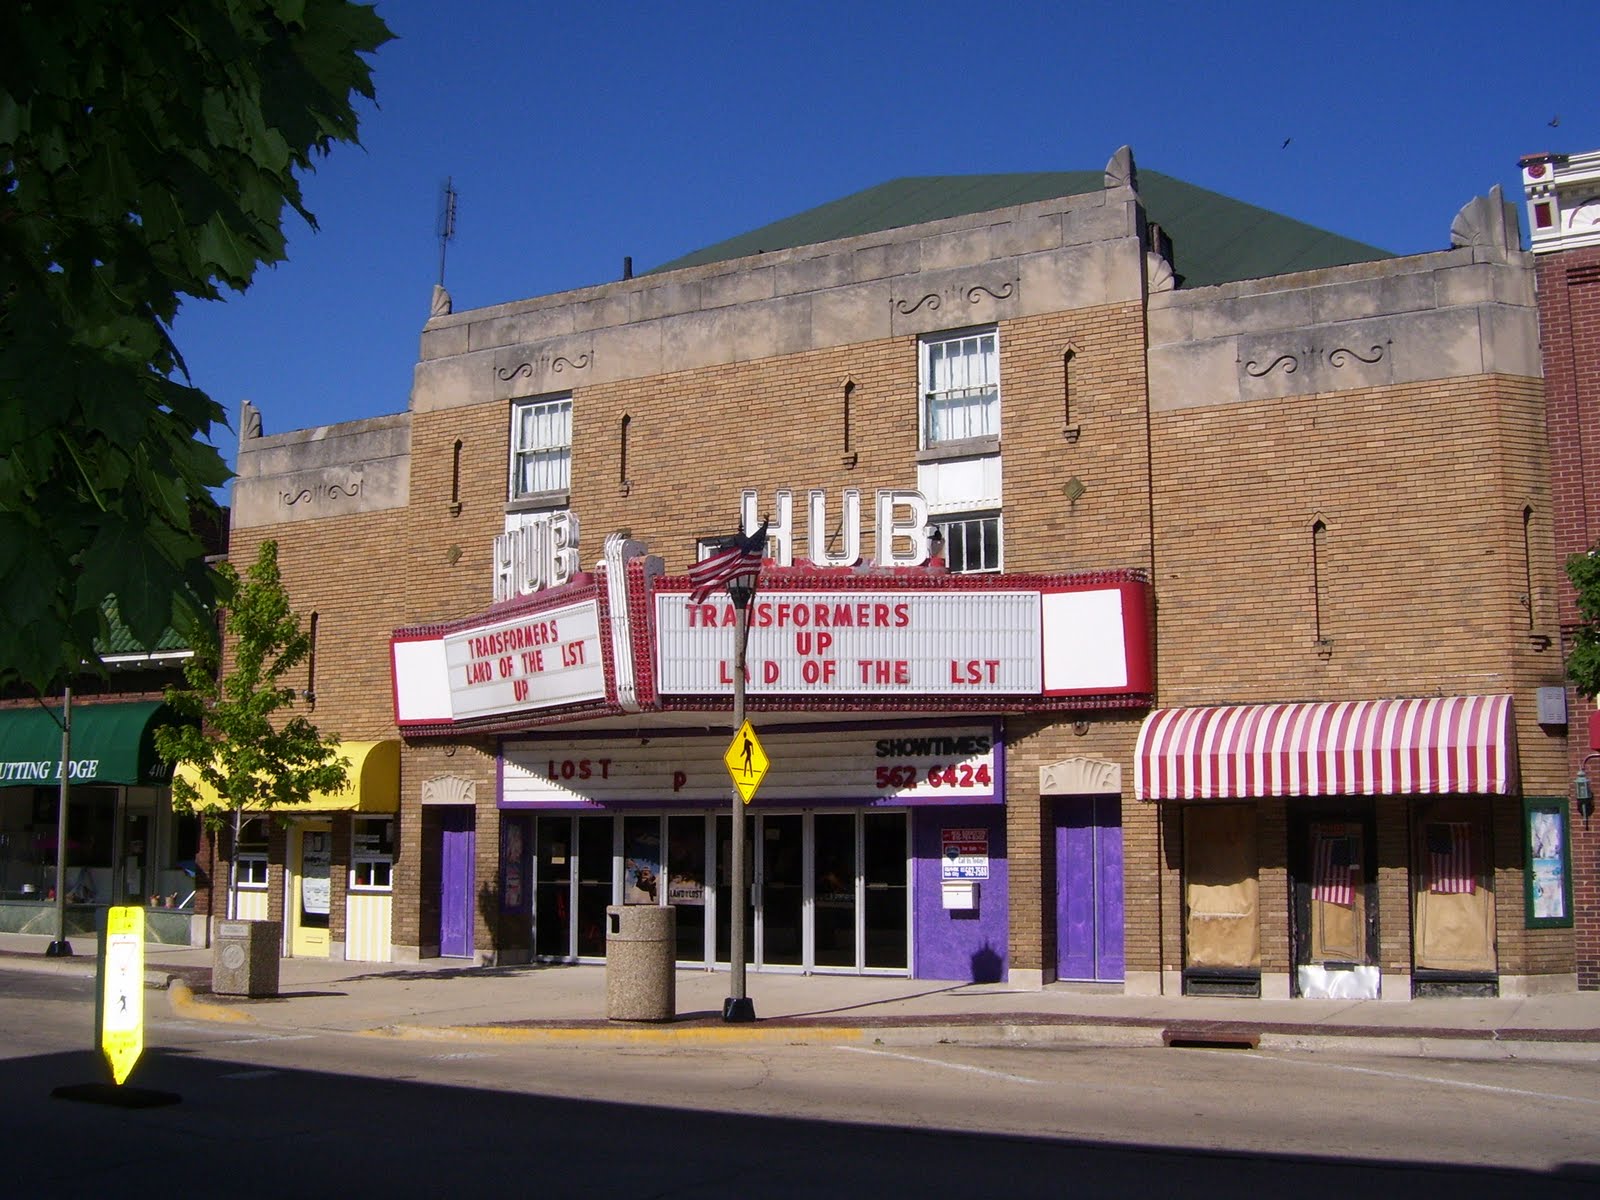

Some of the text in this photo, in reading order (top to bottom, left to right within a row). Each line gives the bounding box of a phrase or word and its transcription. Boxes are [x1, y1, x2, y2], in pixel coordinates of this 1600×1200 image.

[742, 489, 928, 566] HUB
[493, 511, 579, 602] HUB
[467, 619, 559, 659] TRANSFORMERS
[796, 632, 832, 655] UP
[466, 640, 585, 685] LAND OF THE LST
[720, 660, 1000, 684] LD OF THE LST
[513, 679, 529, 701] UP
[876, 735, 991, 757] SHOWTIMES
[548, 758, 612, 780] LOST
[673, 770, 687, 792] P
[876, 764, 991, 789] 562 6424
